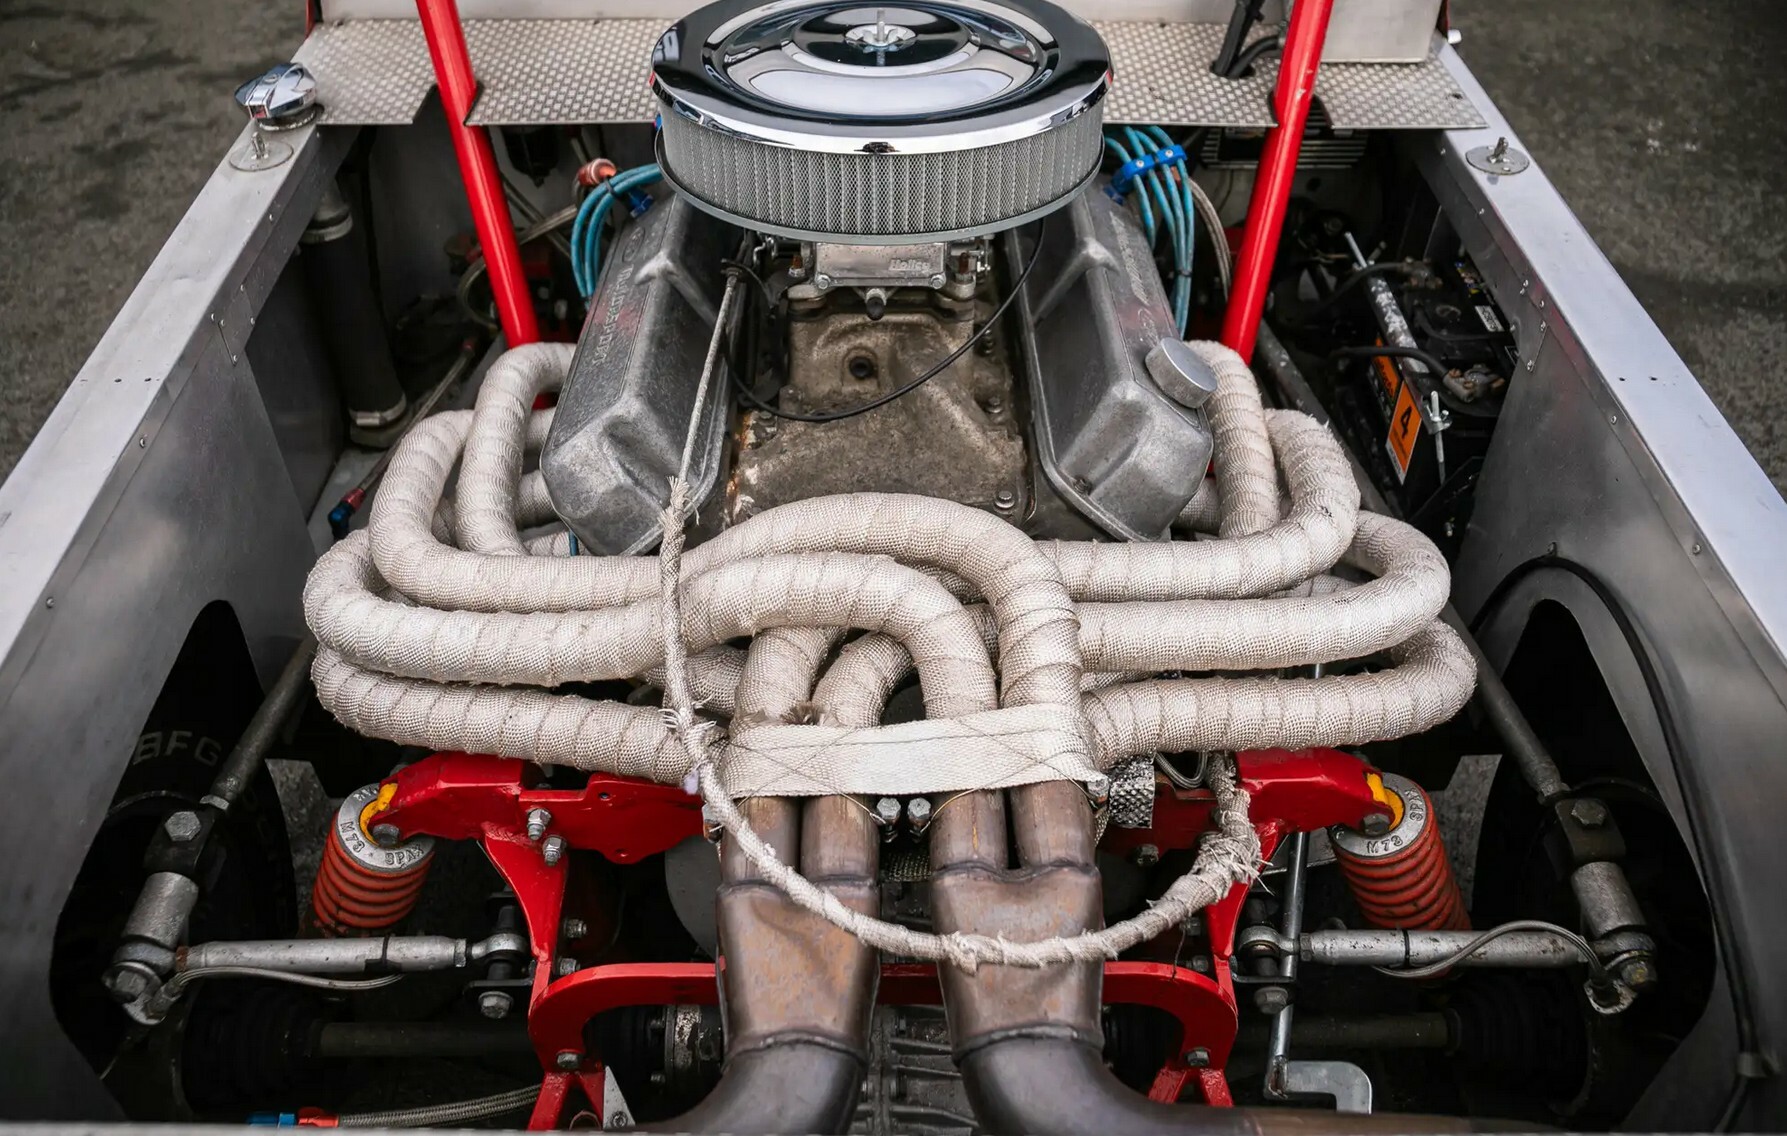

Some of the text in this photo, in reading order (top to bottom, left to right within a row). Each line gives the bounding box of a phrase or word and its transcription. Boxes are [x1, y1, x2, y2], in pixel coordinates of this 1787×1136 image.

[1400, 405, 1413, 440] 4
[1404, 787, 1424, 822] SPAX
[384, 843, 425, 866] SPAX
